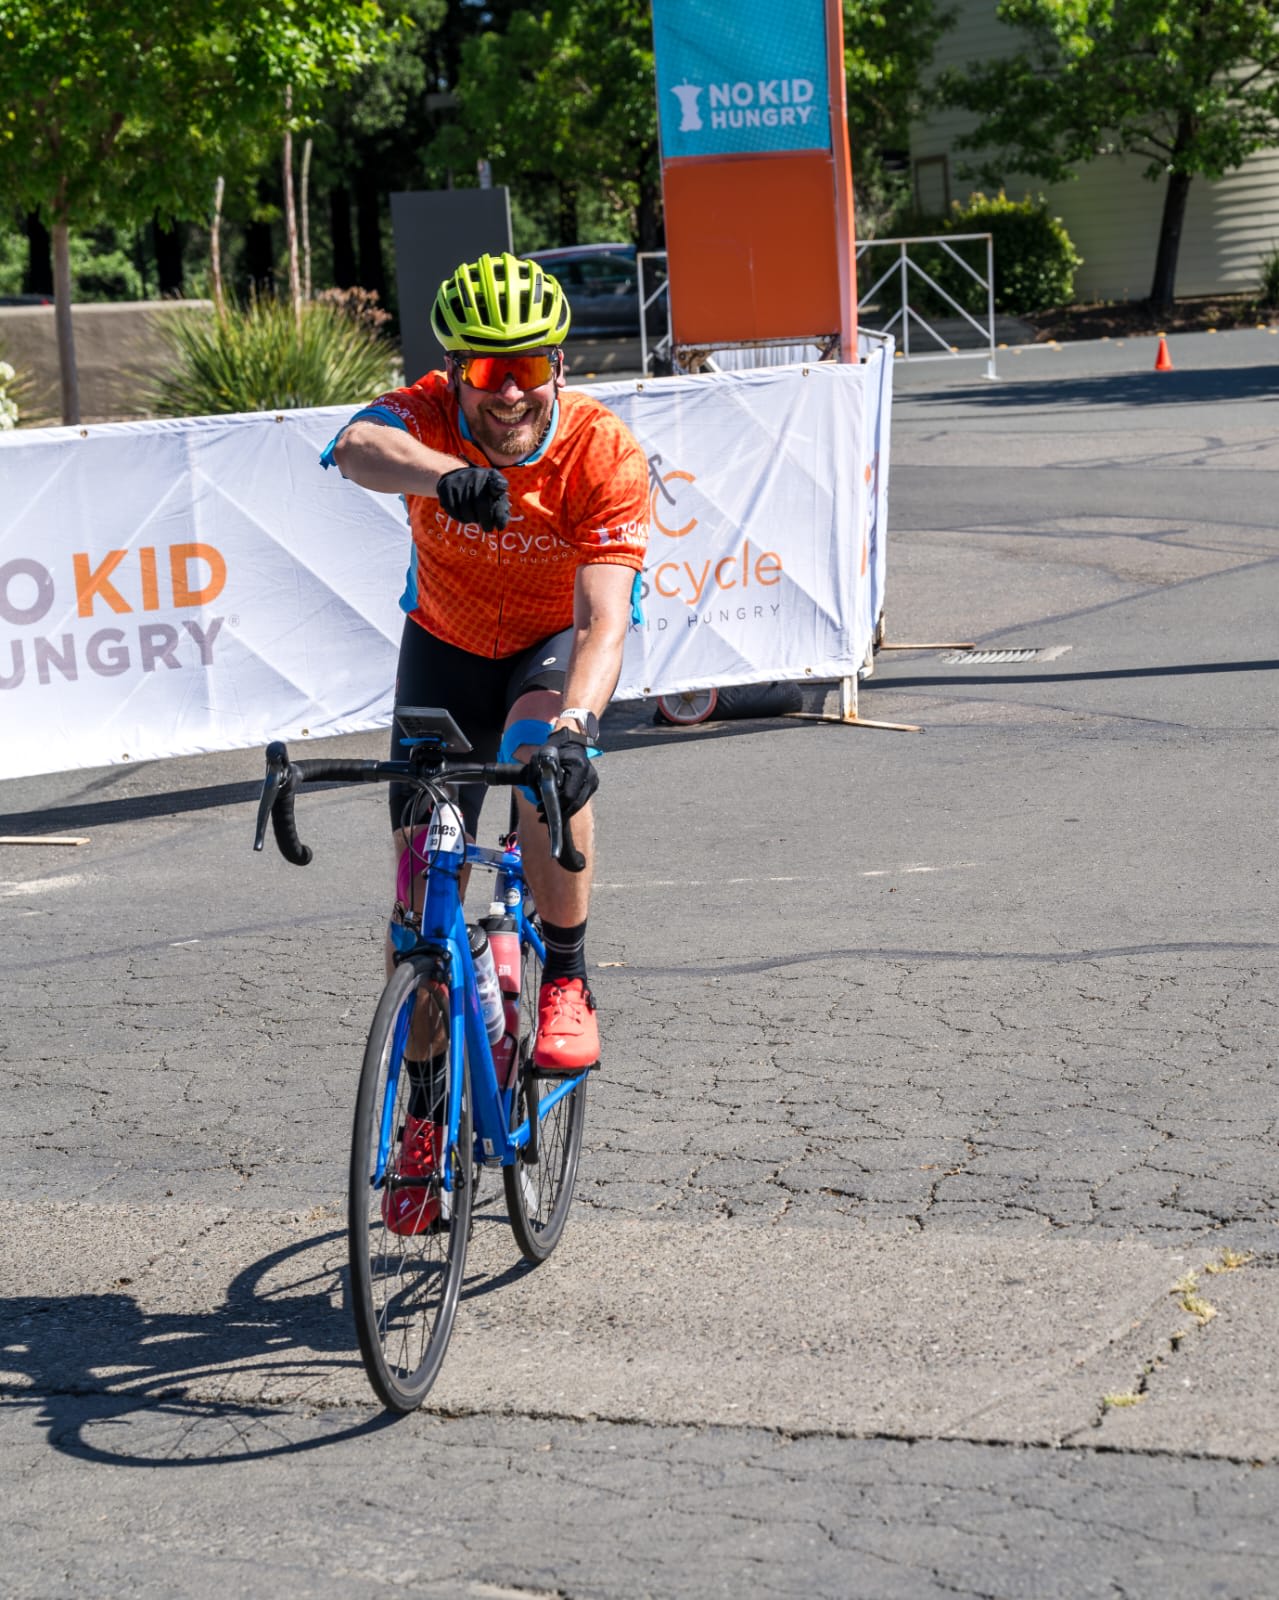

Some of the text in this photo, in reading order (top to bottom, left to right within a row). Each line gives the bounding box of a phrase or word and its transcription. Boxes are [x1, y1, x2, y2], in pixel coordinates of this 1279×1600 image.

[708, 78, 815, 108] NO KID
[711, 106, 813, 129] HUNGRY
[72, 542, 227, 618] KID
[687, 603, 781, 628] HUNGRY
